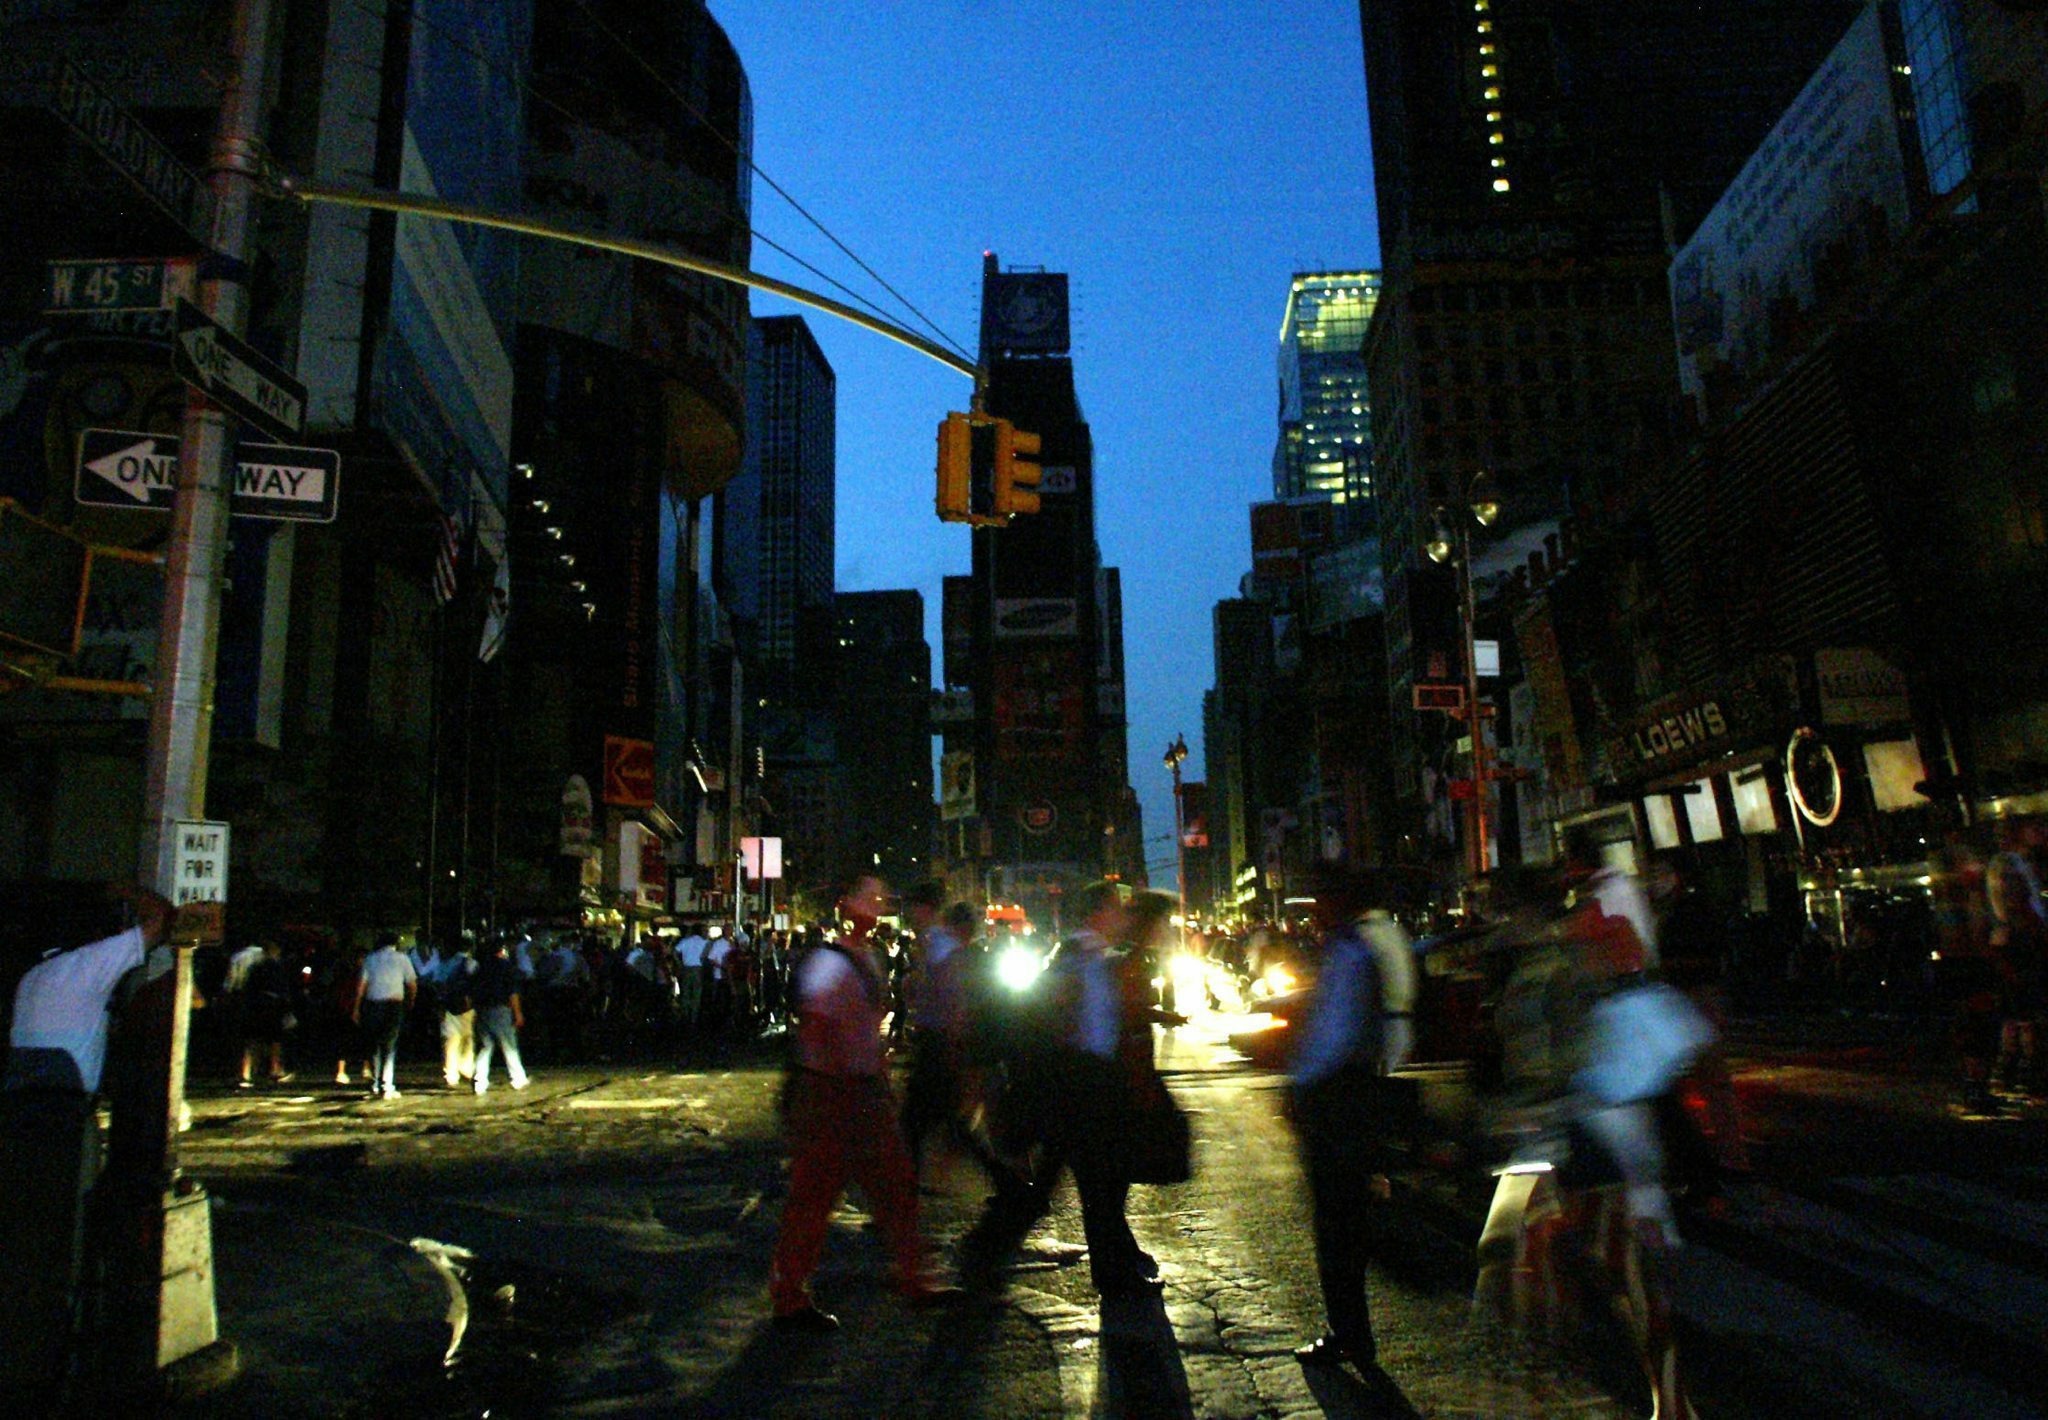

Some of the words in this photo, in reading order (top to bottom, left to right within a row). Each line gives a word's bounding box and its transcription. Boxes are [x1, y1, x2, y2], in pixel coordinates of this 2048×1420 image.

[59, 62, 191, 217] BROADWAY
[51, 264, 76, 306] W
[84, 264, 121, 306] 45
[194, 335, 232, 384] ONE
[256, 379, 293, 420] WAY
[237, 464, 307, 497] WAY
[1633, 700, 1728, 761] LOEWS
[183, 833, 218, 853] WAIT
[184, 860, 214, 879] FOR
